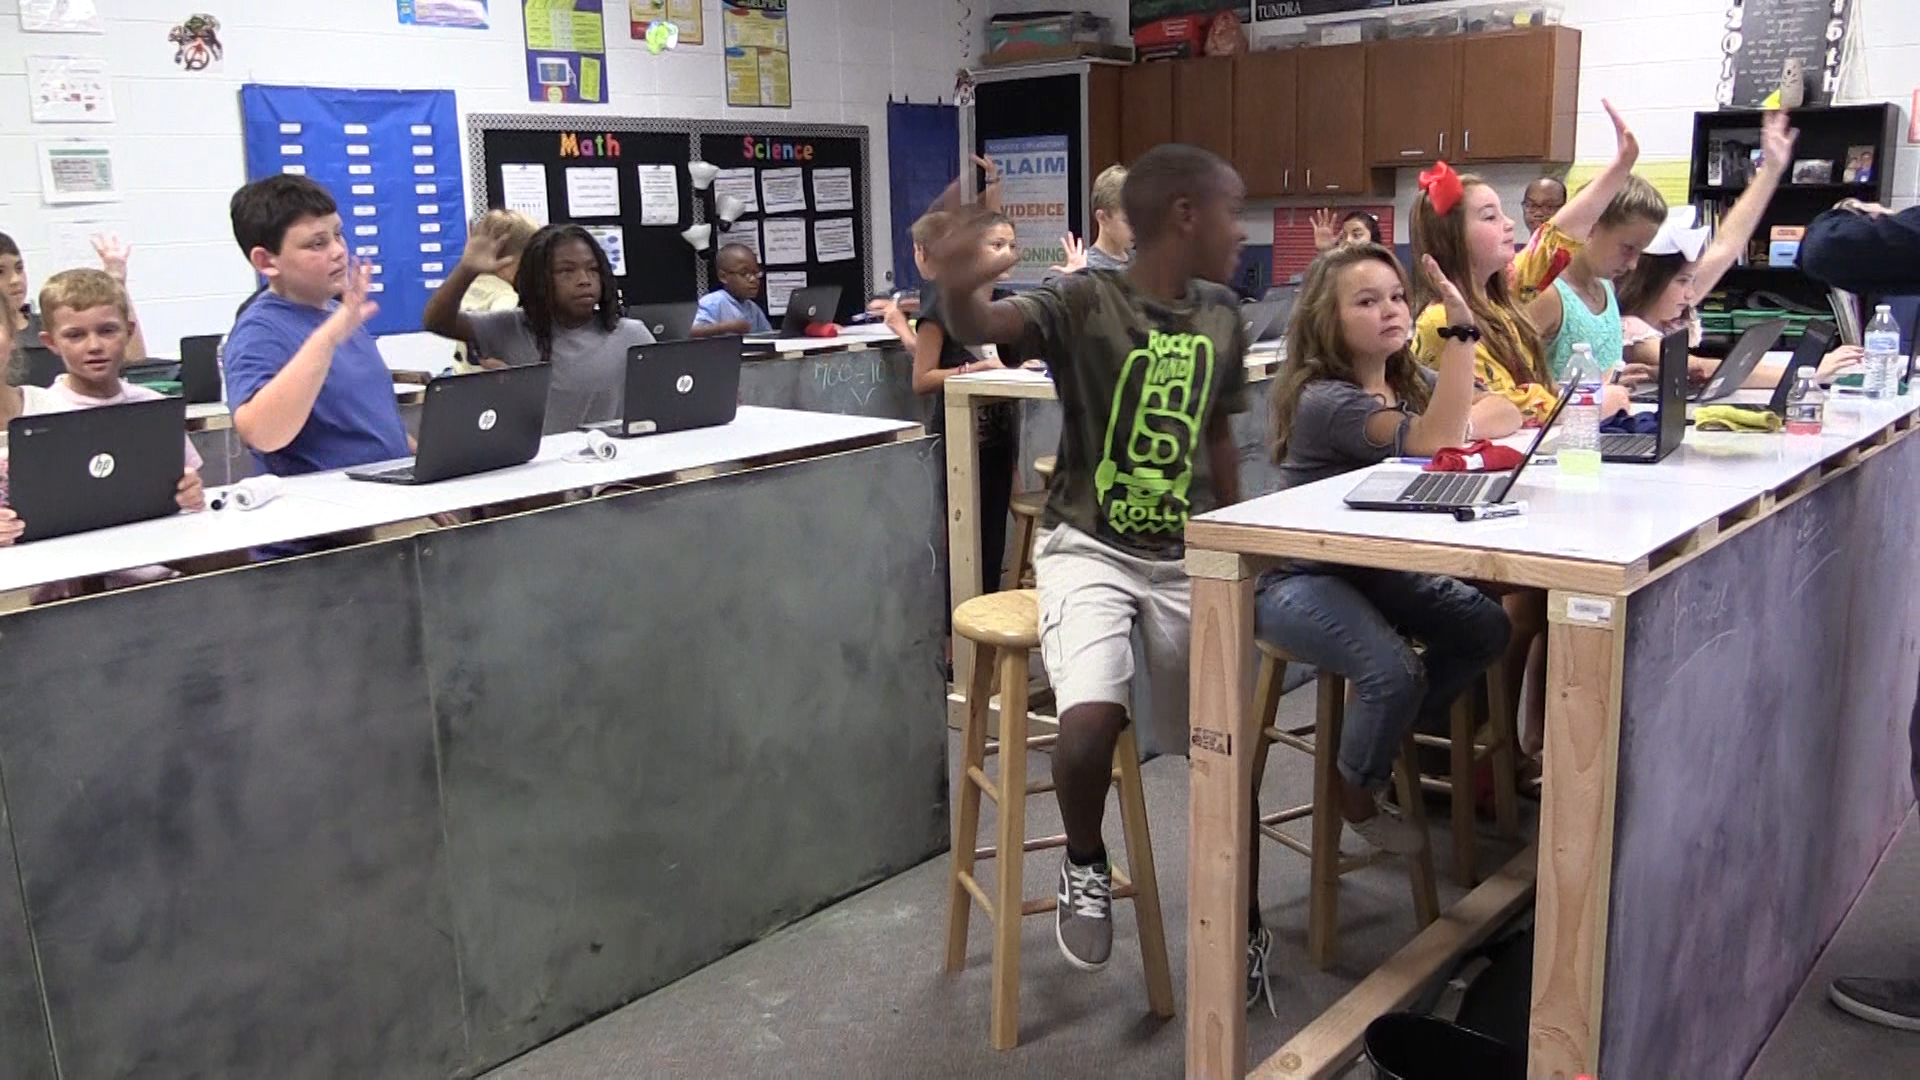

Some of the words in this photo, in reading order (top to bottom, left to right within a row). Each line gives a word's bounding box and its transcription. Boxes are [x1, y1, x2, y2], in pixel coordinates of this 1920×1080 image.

[1258, 2, 1301, 18] TUNDRA
[559, 132, 621, 158] Math
[743, 135, 814, 161] Science
[1000, 203, 1066, 218] VIDENCE
[91, 454, 113, 478] hp
[1110, 501, 1179, 522] ROLL
